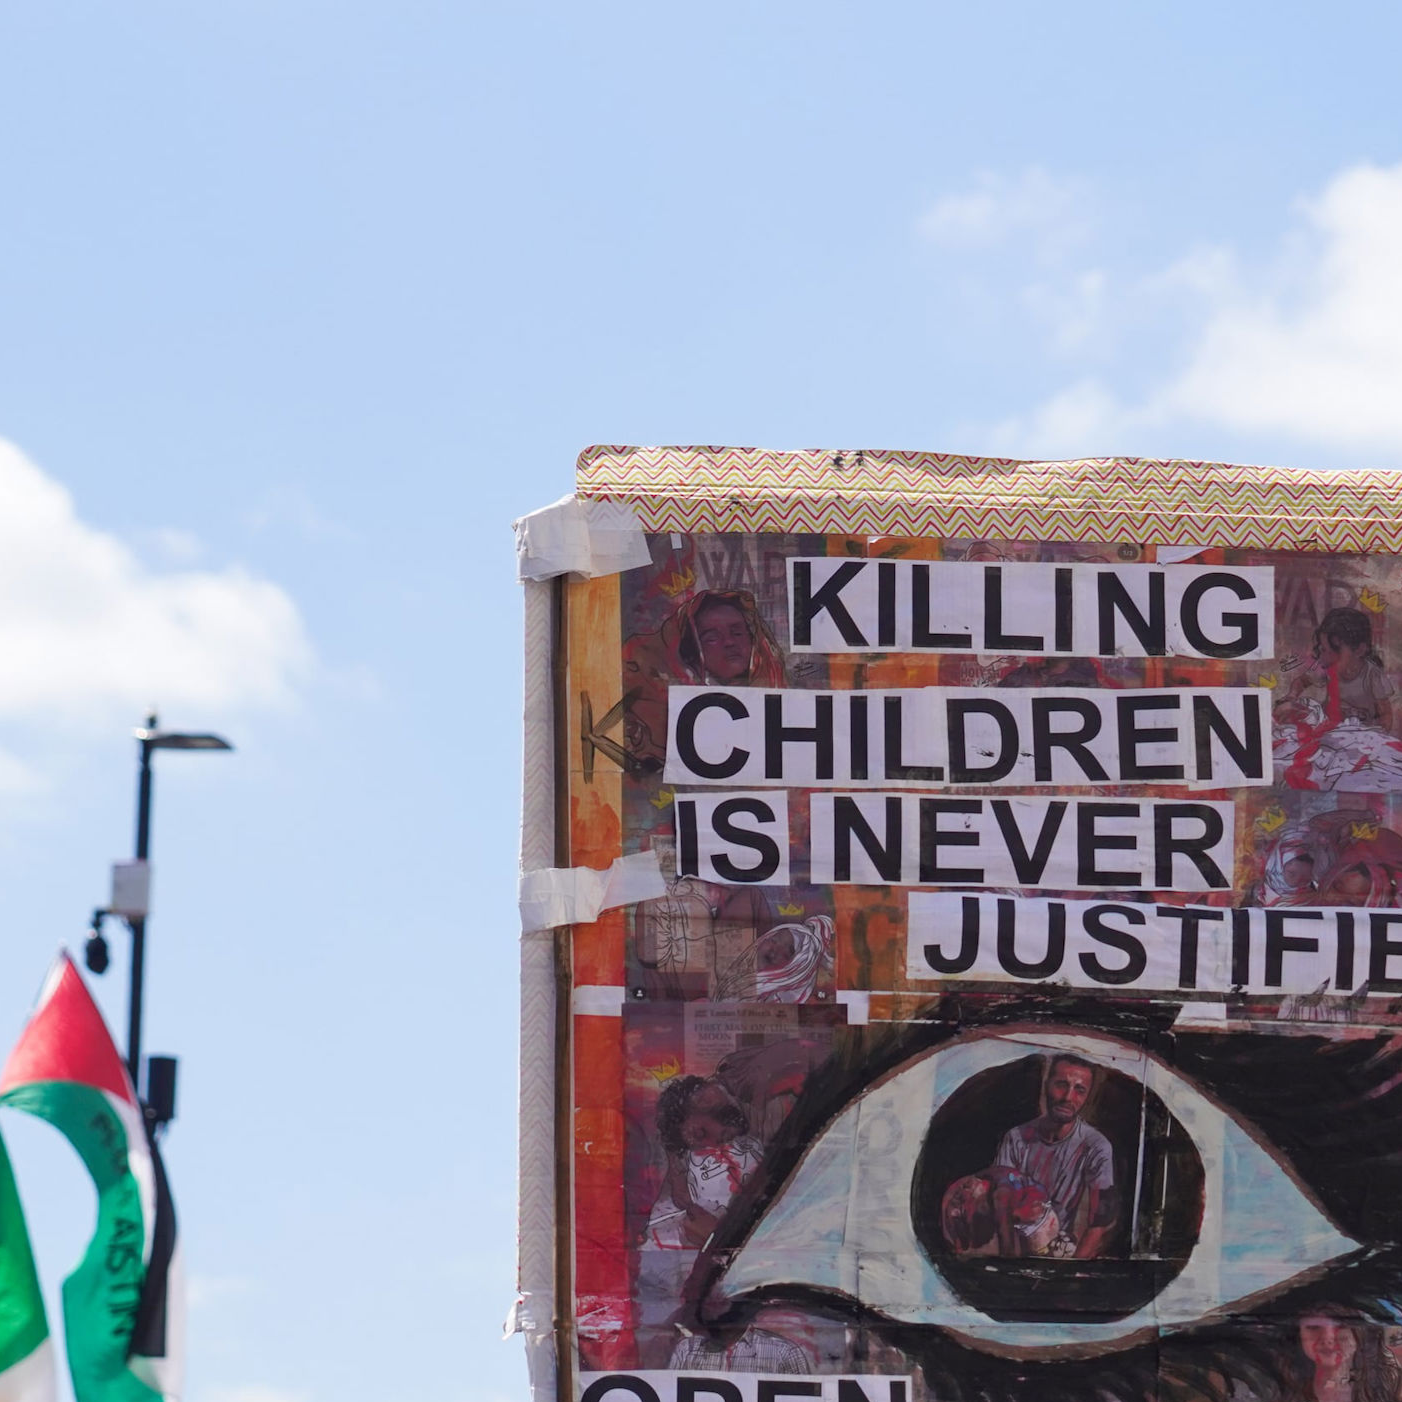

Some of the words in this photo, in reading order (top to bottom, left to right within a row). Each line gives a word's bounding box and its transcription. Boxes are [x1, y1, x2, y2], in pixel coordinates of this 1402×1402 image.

[792, 560, 1260, 660] KILLING
[674, 690, 1265, 784] CHILDREN
[676, 797, 782, 884] IS
[832, 796, 1232, 890] NEVER
